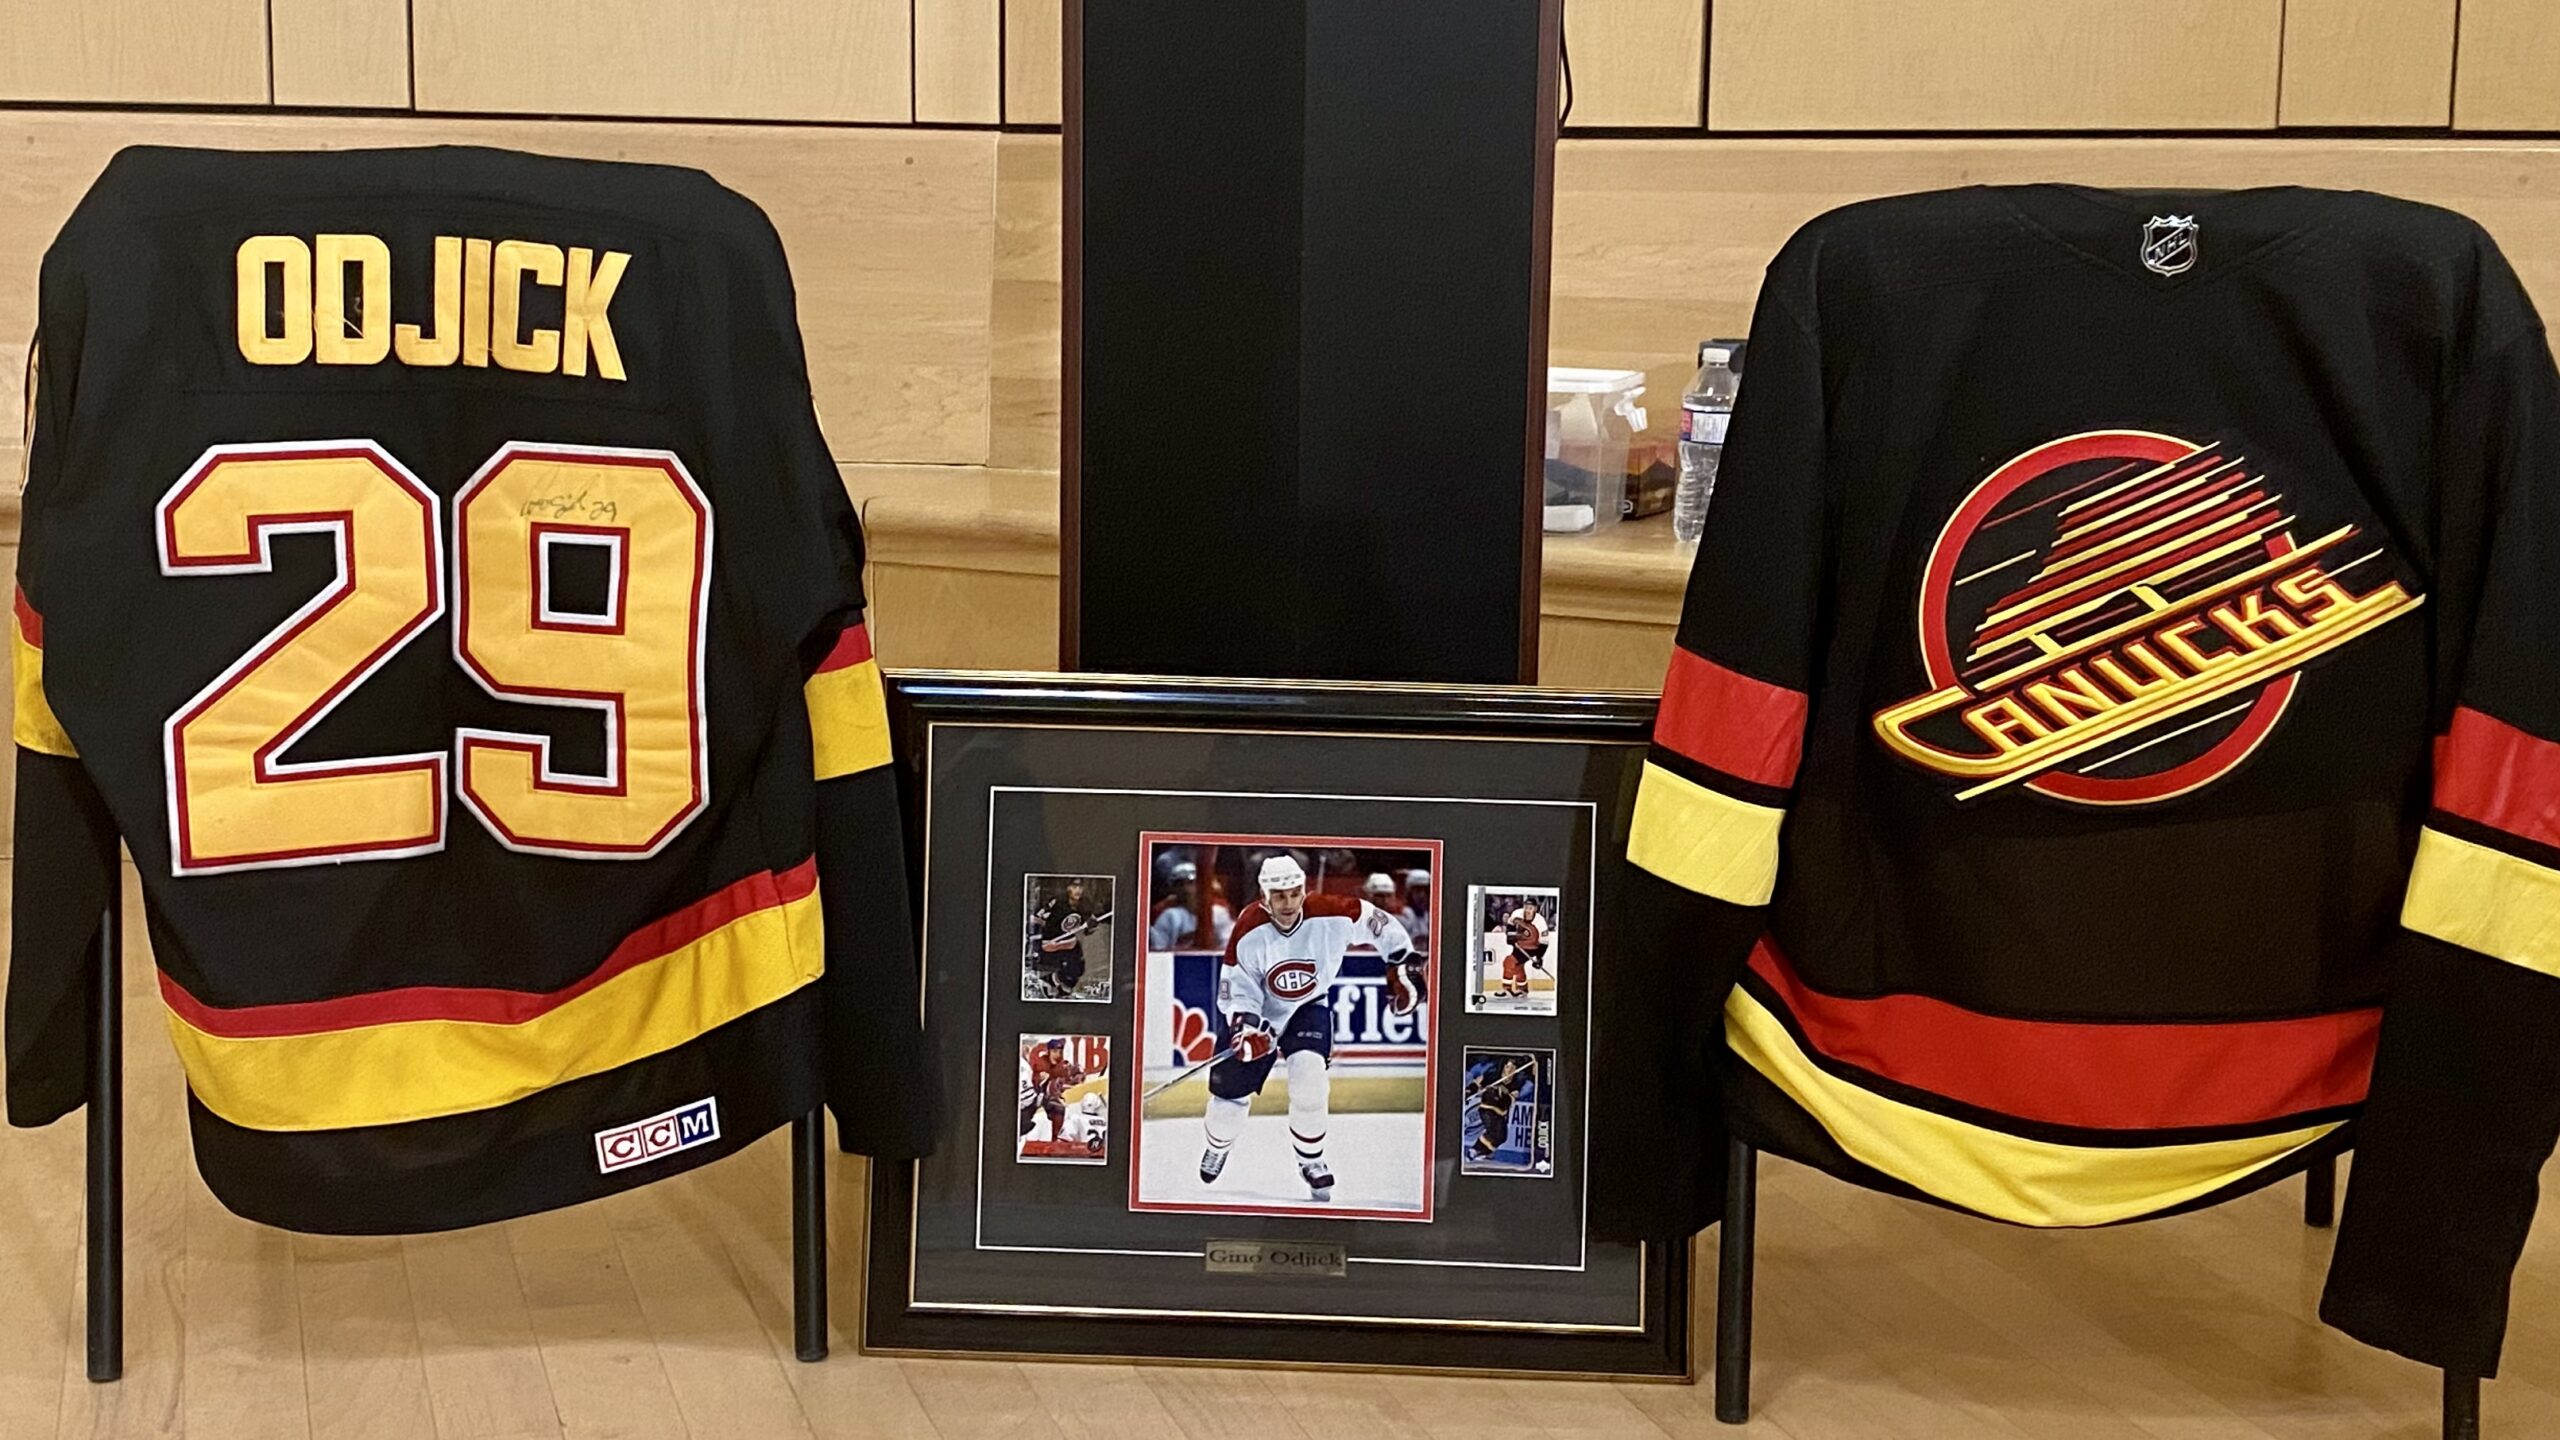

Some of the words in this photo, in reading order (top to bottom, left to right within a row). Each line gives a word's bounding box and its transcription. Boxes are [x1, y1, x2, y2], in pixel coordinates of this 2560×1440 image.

[2155, 232, 2188, 262] NHL
[236, 233, 632, 382] ODJICK
[155, 439, 713, 877] 29
[607, 1110, 710, 1158] CCM
[1209, 1249, 1263, 1264] Gino
[1270, 1250, 1342, 1267] Odjick
